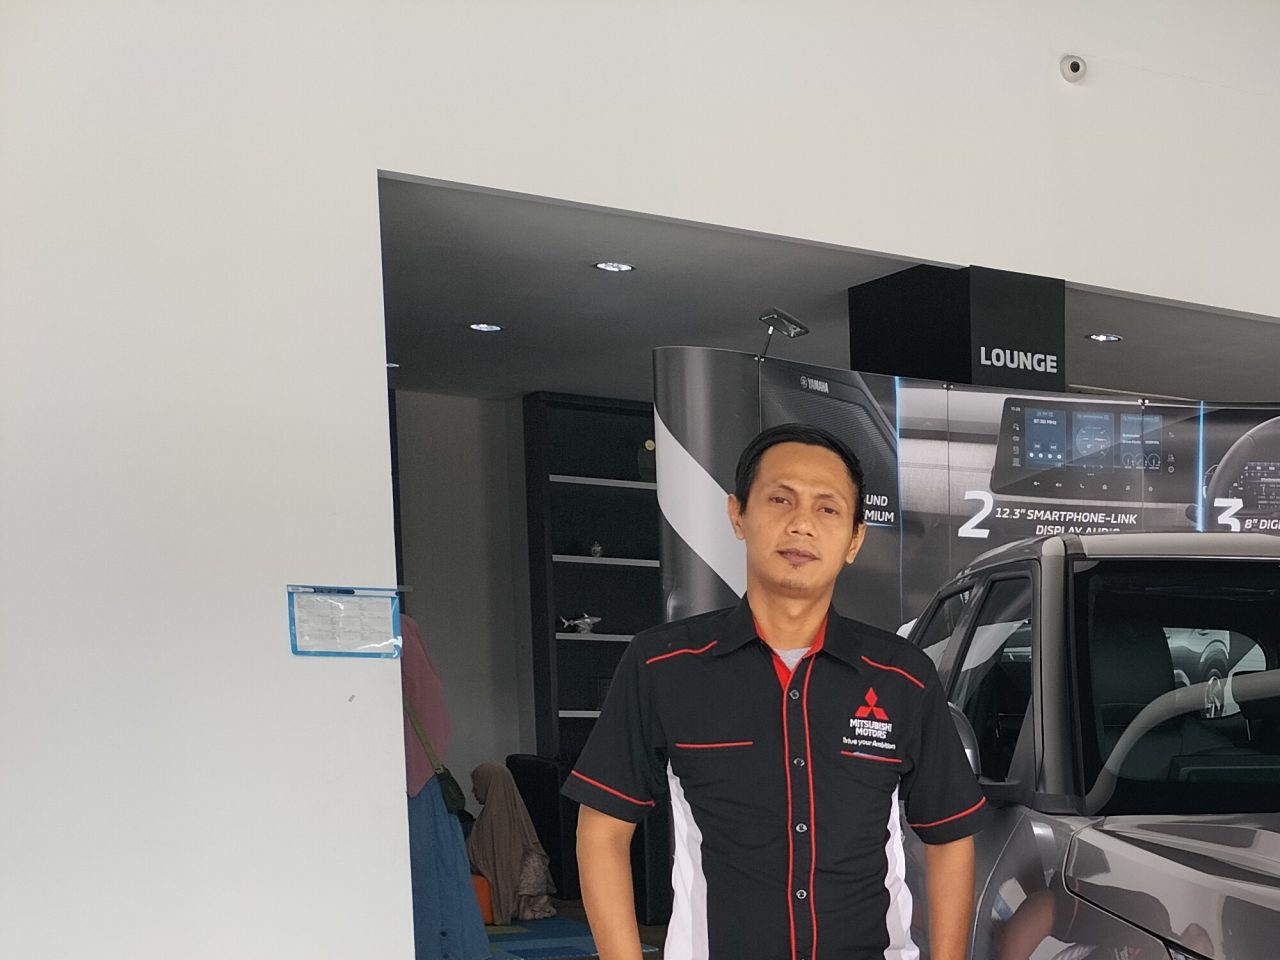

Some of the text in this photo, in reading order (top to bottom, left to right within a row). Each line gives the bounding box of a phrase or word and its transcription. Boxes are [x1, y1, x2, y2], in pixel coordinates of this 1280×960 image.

[980, 346, 1058, 373] LOUNGE
[807, 377, 829, 394] YAMAHA
[864, 494, 888, 506] UND
[863, 509, 895, 522] MIUM
[958, 490, 994, 539] 2
[995, 507, 1138, 525] 12.3" SMARTPHONE-LINK
[1213, 498, 1244, 532] 3
[1244, 519, 1258, 529] 8"
[849, 718, 892, 732] MITSUBISHI
[855, 727, 887, 739] MOTORS
